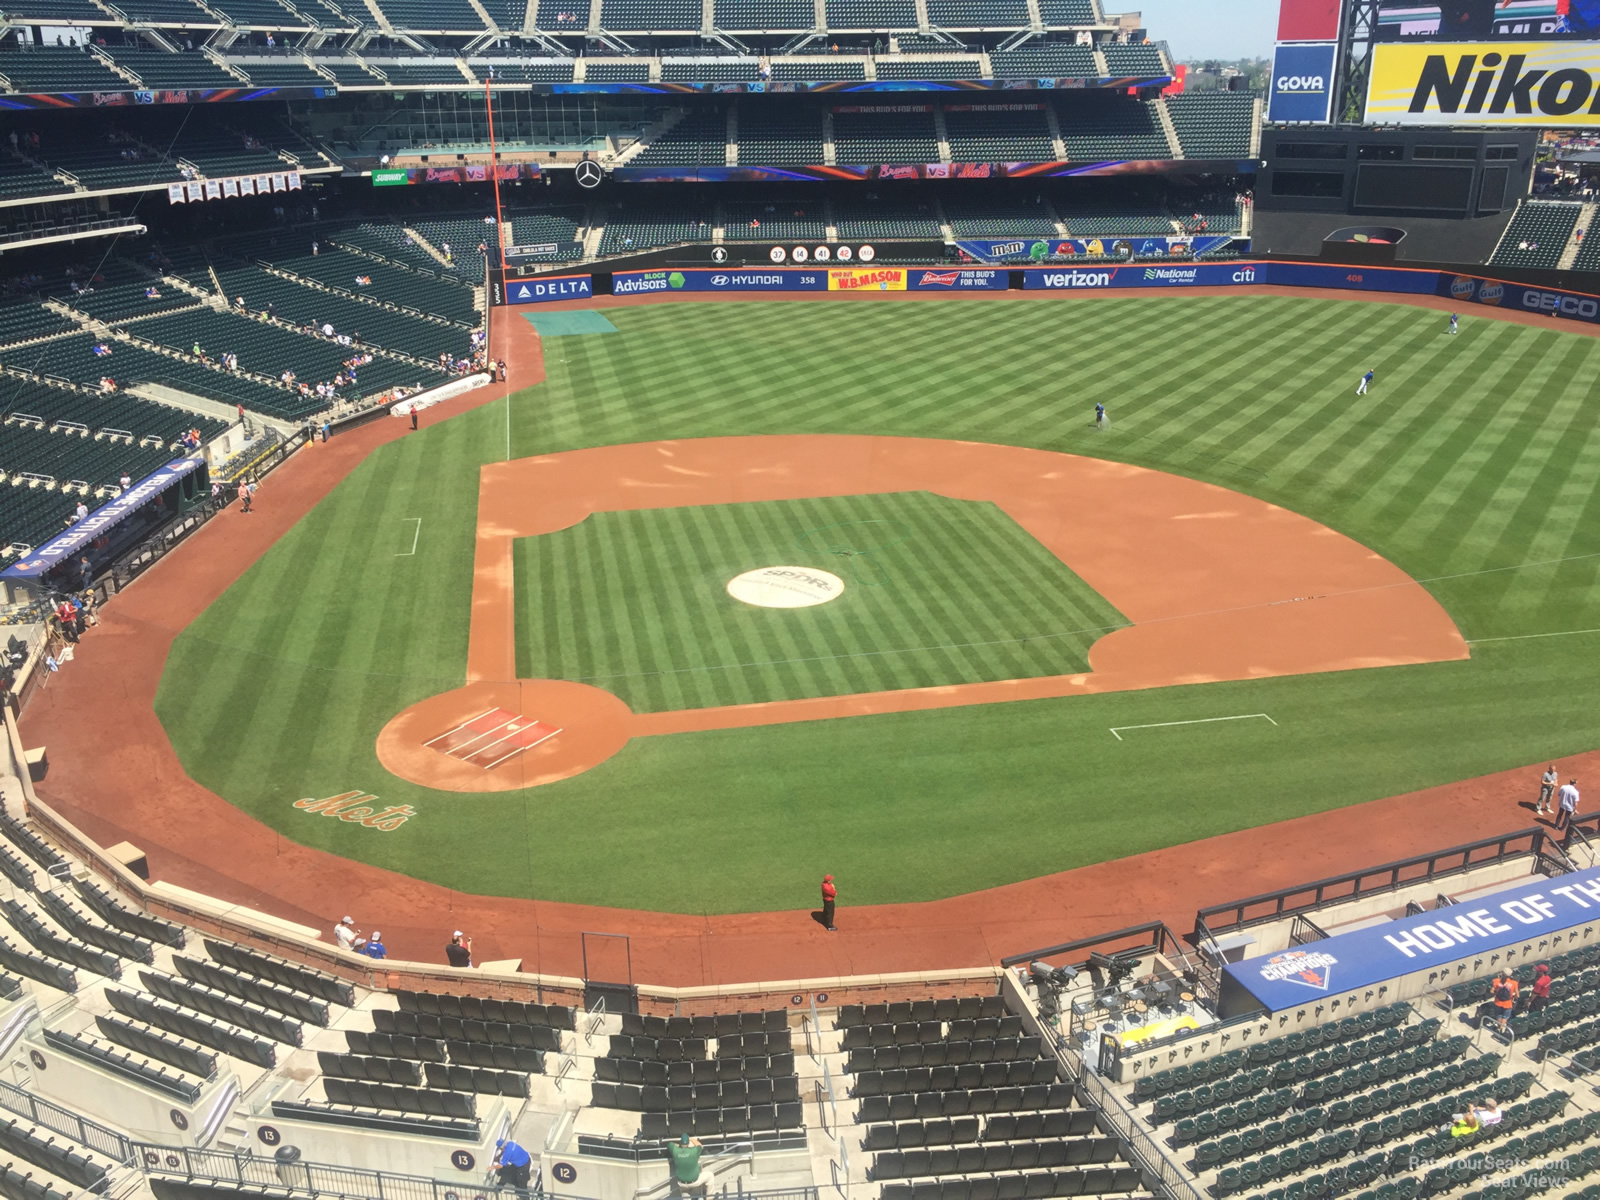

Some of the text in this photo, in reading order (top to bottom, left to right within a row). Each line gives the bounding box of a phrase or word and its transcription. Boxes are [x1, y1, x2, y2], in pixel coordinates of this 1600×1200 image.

[748, 83, 764, 92] VS
[1038, 79, 1054, 88] VS
[1277, 76, 1323, 90] GOYA
[1408, 52, 1600, 116] Niko
[135, 92, 153, 104] VS
[467, 170, 484, 179] VS
[928, 167, 946, 177] VS
[957, 163, 990, 178] Mets
[375, 173, 405, 182] SUBWAY
[839, 249, 849, 257] 42
[644, 272, 666, 280] BLOCK
[923, 272, 957, 282] Budweiser
[976, 270, 995, 278] BUD'S
[1155, 268, 1196, 278] National
[1232, 268, 1255, 282] citi
[1346, 274, 1363, 282] 408
[732, 275, 783, 284] HYUNDAI
[800, 276, 816, 284] 358
[1043, 270, 1109, 287] verizon
[536, 281, 589, 295] DELTA
[614, 278, 667, 292] Advisors
[1452, 282, 1473, 292] Gulf
[1480, 287, 1502, 298] Gulf
[39, 532, 88, 556] FIELD
[292, 789, 417, 832] Mets
[1383, 877, 1600, 958] HOME OF TH
[1259, 953, 1338, 981] CHAMPIONS
[264, 1131, 275, 1140] 13
[458, 1155, 468, 1165] 13
[560, 1168, 570, 1178] 12
